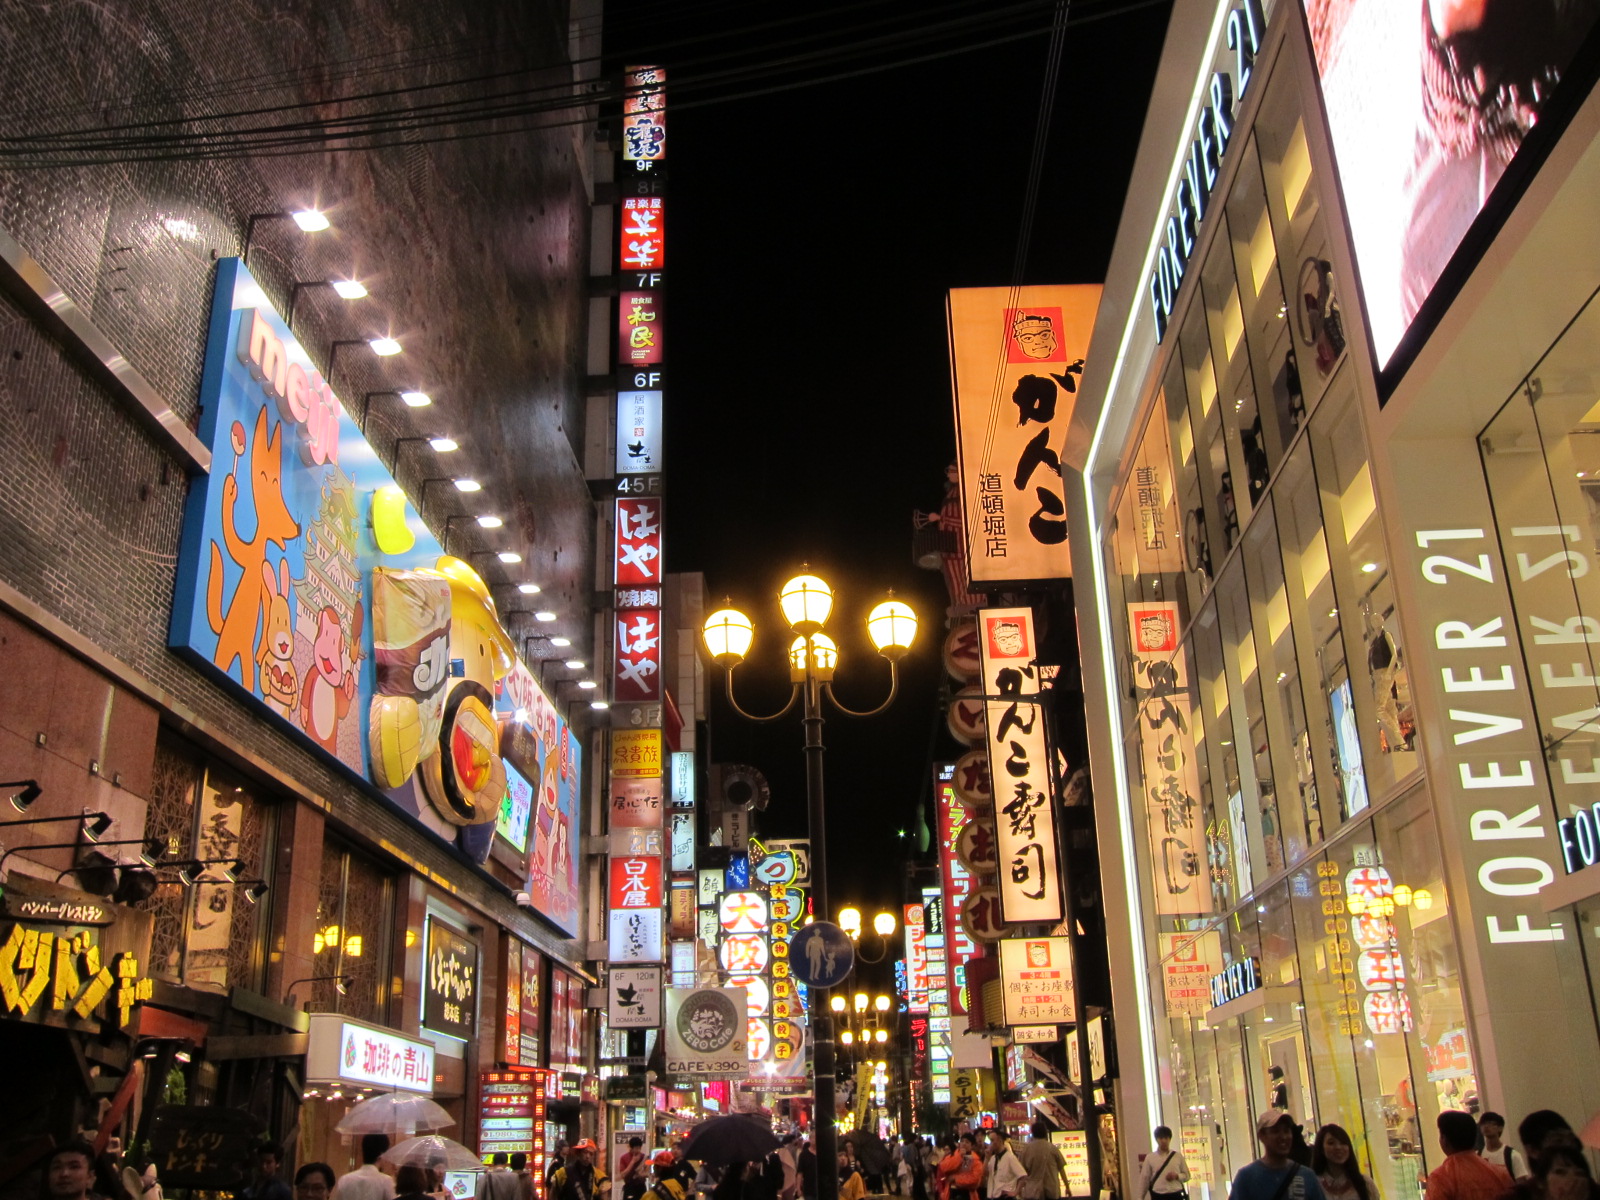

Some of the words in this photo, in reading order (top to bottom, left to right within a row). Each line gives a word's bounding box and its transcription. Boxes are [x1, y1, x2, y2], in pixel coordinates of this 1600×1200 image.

[636, 160, 653, 171] 9F
[1151, 72, 1234, 345] FOREVER
[636, 273, 662, 287] 7F
[627, 305, 656, 348] 和民
[249, 308, 341, 465] meiji
[634, 372, 661, 387] 6F
[980, 473, 1007, 558] 道頓堀店
[618, 504, 659, 577] はや
[1416, 528, 1494, 584] 21
[618, 589, 658, 607] 焼肉
[618, 616, 659, 694] はや
[613, 745, 658, 763] 鳥貴族
[995, 657, 1046, 900] がんこ寿司
[1435, 616, 1566, 944] FOREVER
[629, 834, 658, 853] 2F
[620, 858, 651, 907] 白木屋
[21, 901, 103, 921] ハンバーグレストラン
[1209, 963, 1245, 1008] FOREVER
[1244, 957, 1256, 993] 21
[1018, 1004, 1072, 1018] 寿司・和食
[682, 1028, 708, 1049] ZERO
[733, 1041, 746, 1051] 2F
[363, 1037, 429, 1085] 珈琲の青山
[668, 1061, 705, 1071] CAFE
